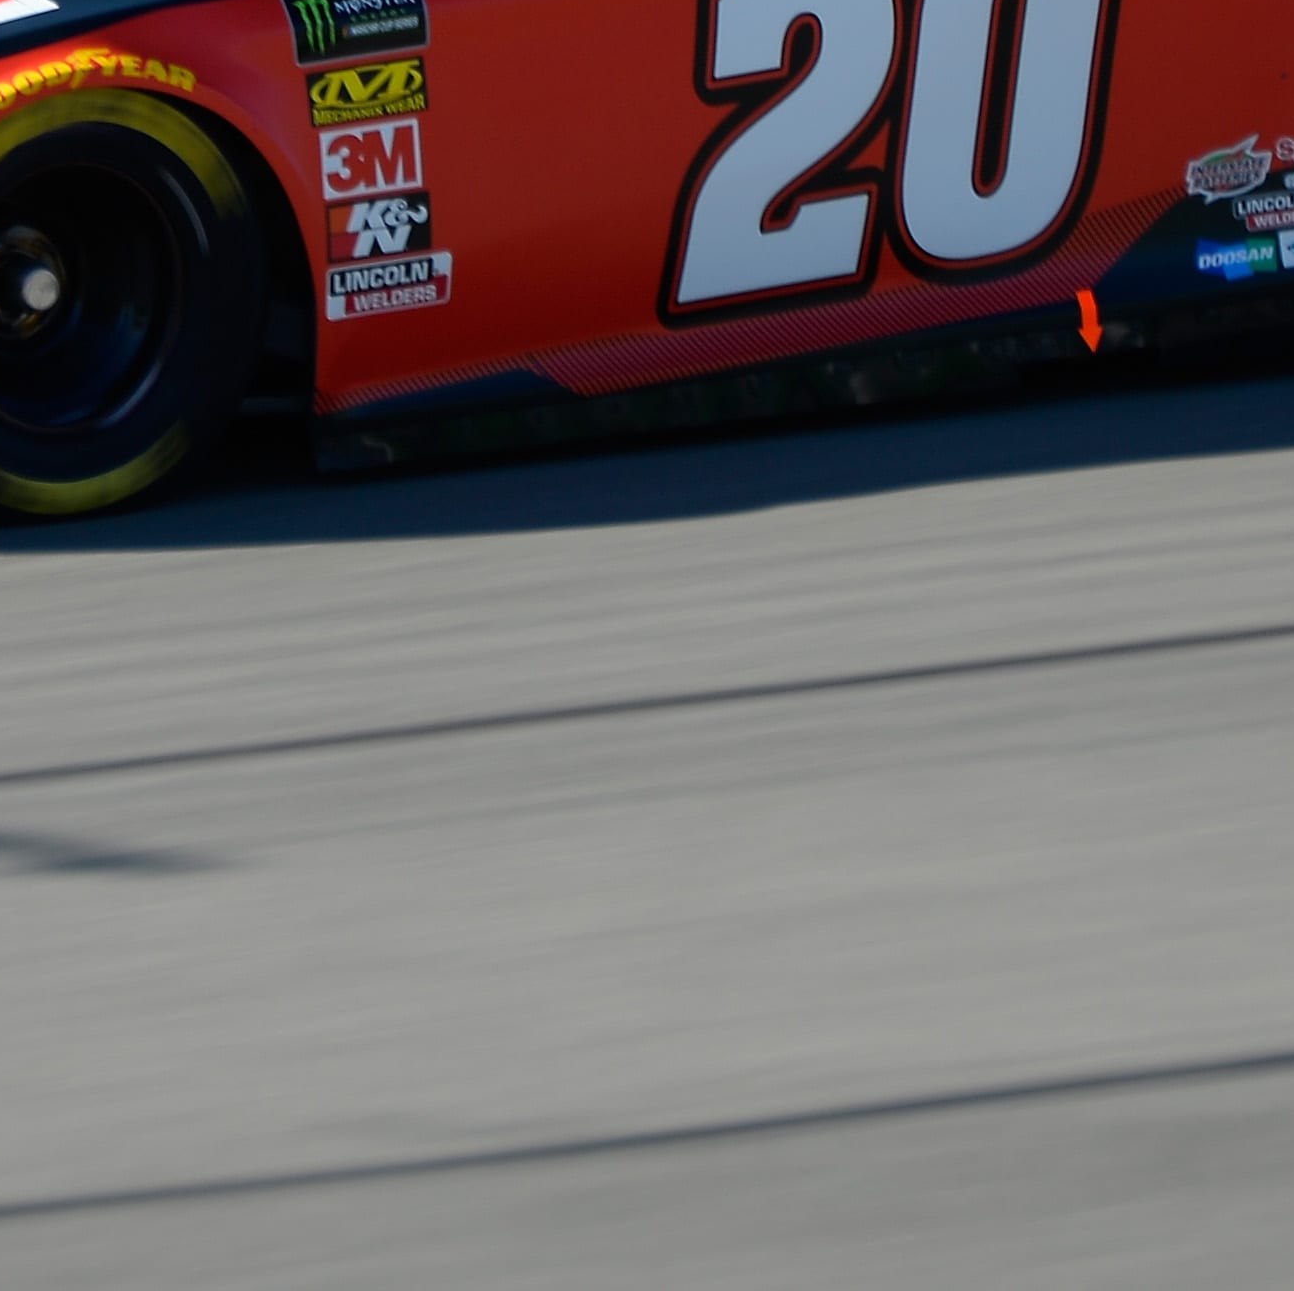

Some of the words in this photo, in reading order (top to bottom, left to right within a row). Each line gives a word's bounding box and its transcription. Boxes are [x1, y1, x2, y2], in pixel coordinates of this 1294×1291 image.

[327, 126, 417, 192] 3M
[1199, 245, 1275, 270] DOOSAN
[333, 260, 429, 293] LINCOLN
[354, 284, 438, 313] WELDERS
